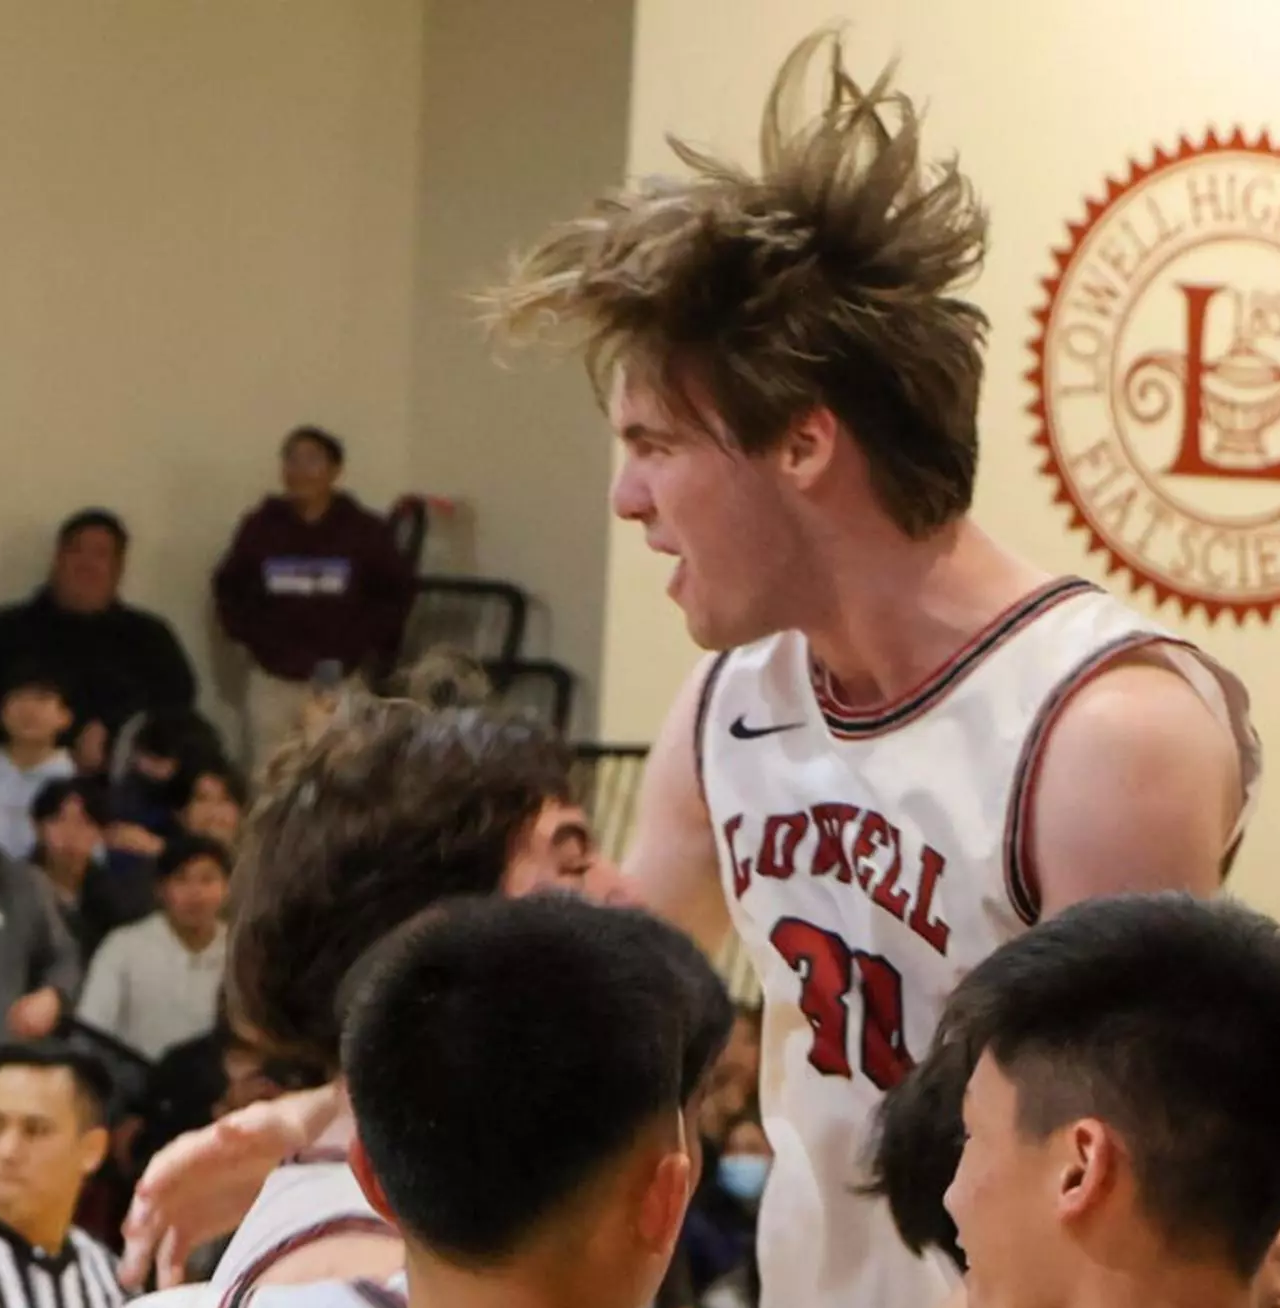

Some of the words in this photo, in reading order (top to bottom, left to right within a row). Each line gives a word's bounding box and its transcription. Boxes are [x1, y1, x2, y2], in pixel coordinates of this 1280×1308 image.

[1058, 193, 1186, 395] LOWELL
[1072, 440, 1176, 557] FIAT
[724, 802, 951, 956] LOWELL
